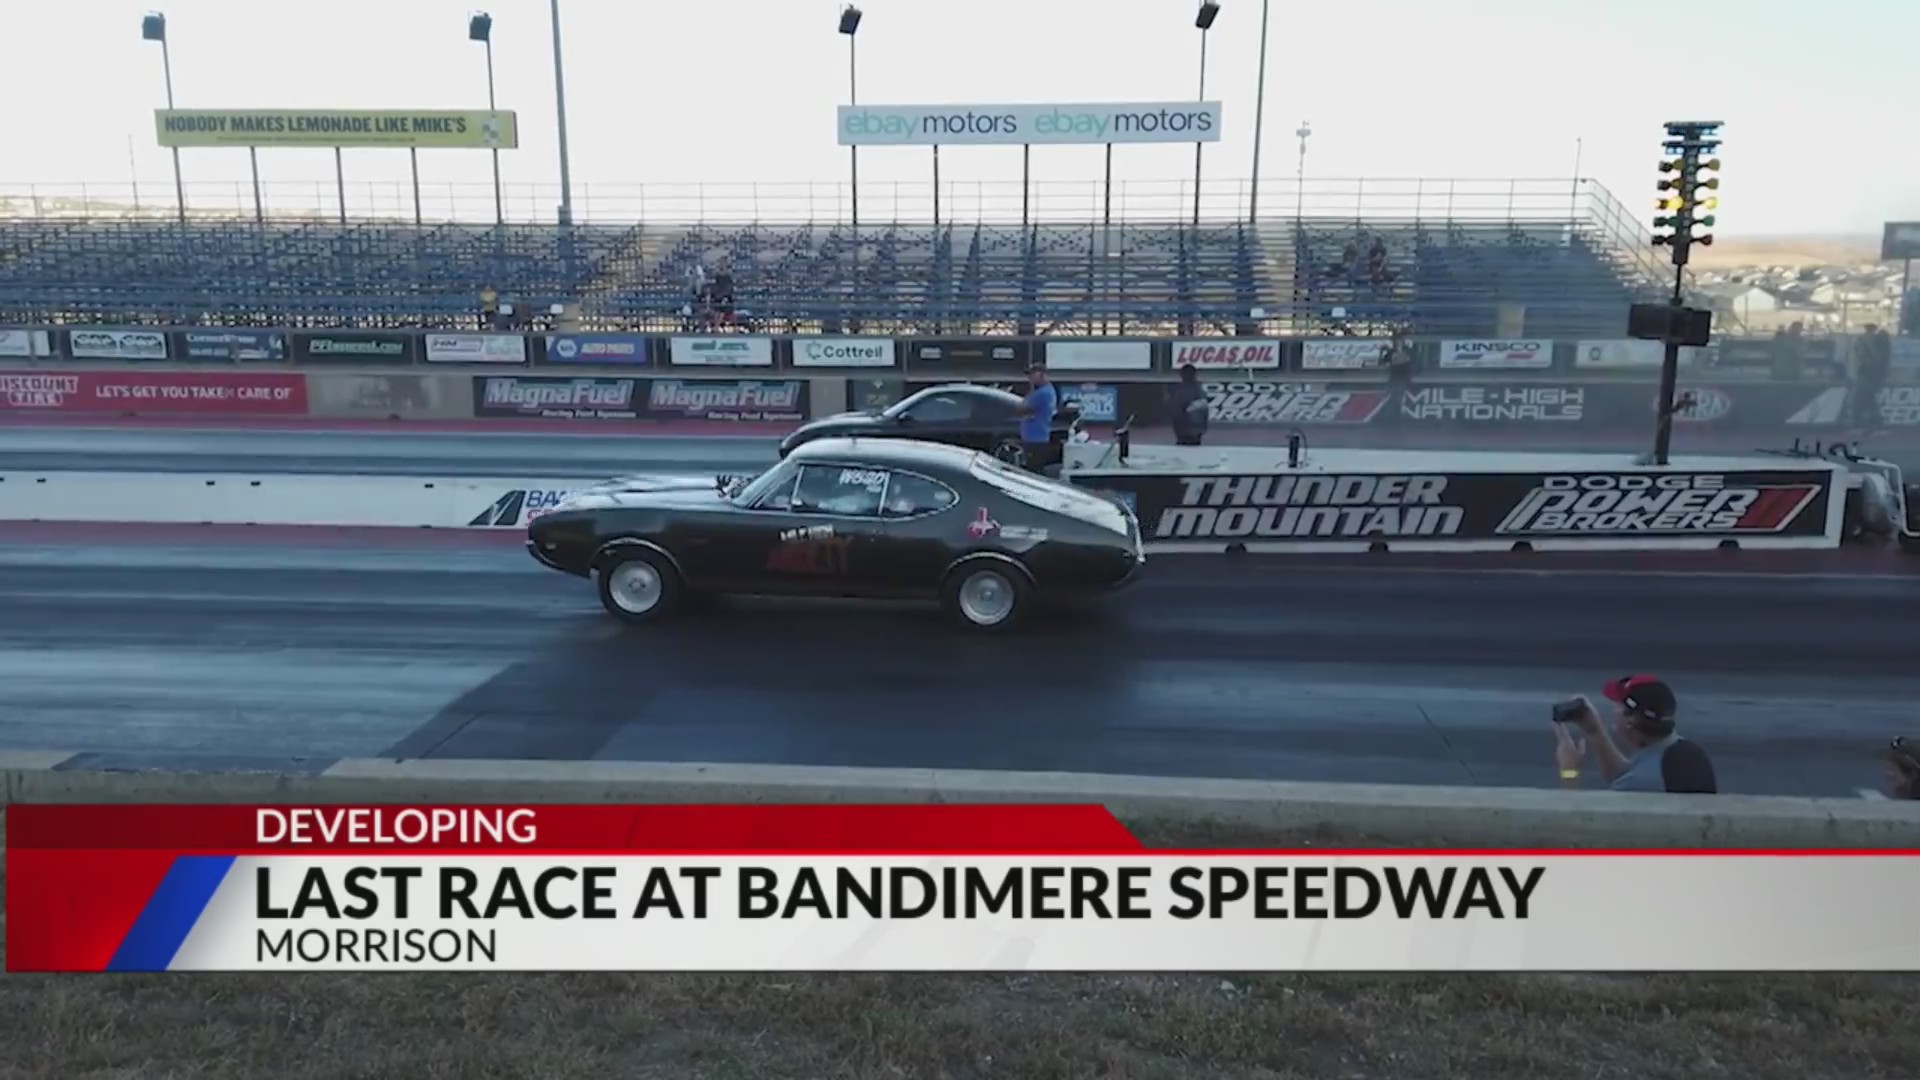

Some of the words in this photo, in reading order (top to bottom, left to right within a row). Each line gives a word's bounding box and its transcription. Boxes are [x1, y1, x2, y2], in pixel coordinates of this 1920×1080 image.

[165, 115, 227, 132] NOBODY
[230, 115, 285, 132] MAKES
[288, 116, 372, 133] LEMONADE
[375, 117, 409, 133] LIKE
[412, 117, 467, 134] MIKE'S
[846, 110, 919, 139] ebay
[923, 111, 1017, 134] motors
[1035, 108, 1111, 138] ebay
[1114, 108, 1212, 132] motors
[823, 345, 883, 359] Cottrell
[1176, 346, 1237, 363] LUCAS
[1242, 345, 1274, 362] OIL
[1455, 343, 1541, 353] KINSCO
[96, 385, 130, 398] LET'S
[132, 385, 157, 398] GET
[162, 386, 188, 398] YOU
[237, 387, 272, 399] CARE
[274, 387, 293, 399] OF
[487, 380, 630, 408] MagnaFuel
[653, 382, 796, 410] MagnaFuel
[1403, 404, 1583, 421] NATIONALS
[1178, 475, 1448, 505] THUNDER
[1543, 475, 1724, 489] DODGE
[1532, 489, 1759, 513] POWER
[1155, 506, 1465, 538] MOUNTAIN
[1530, 511, 1739, 530] BROKERS
